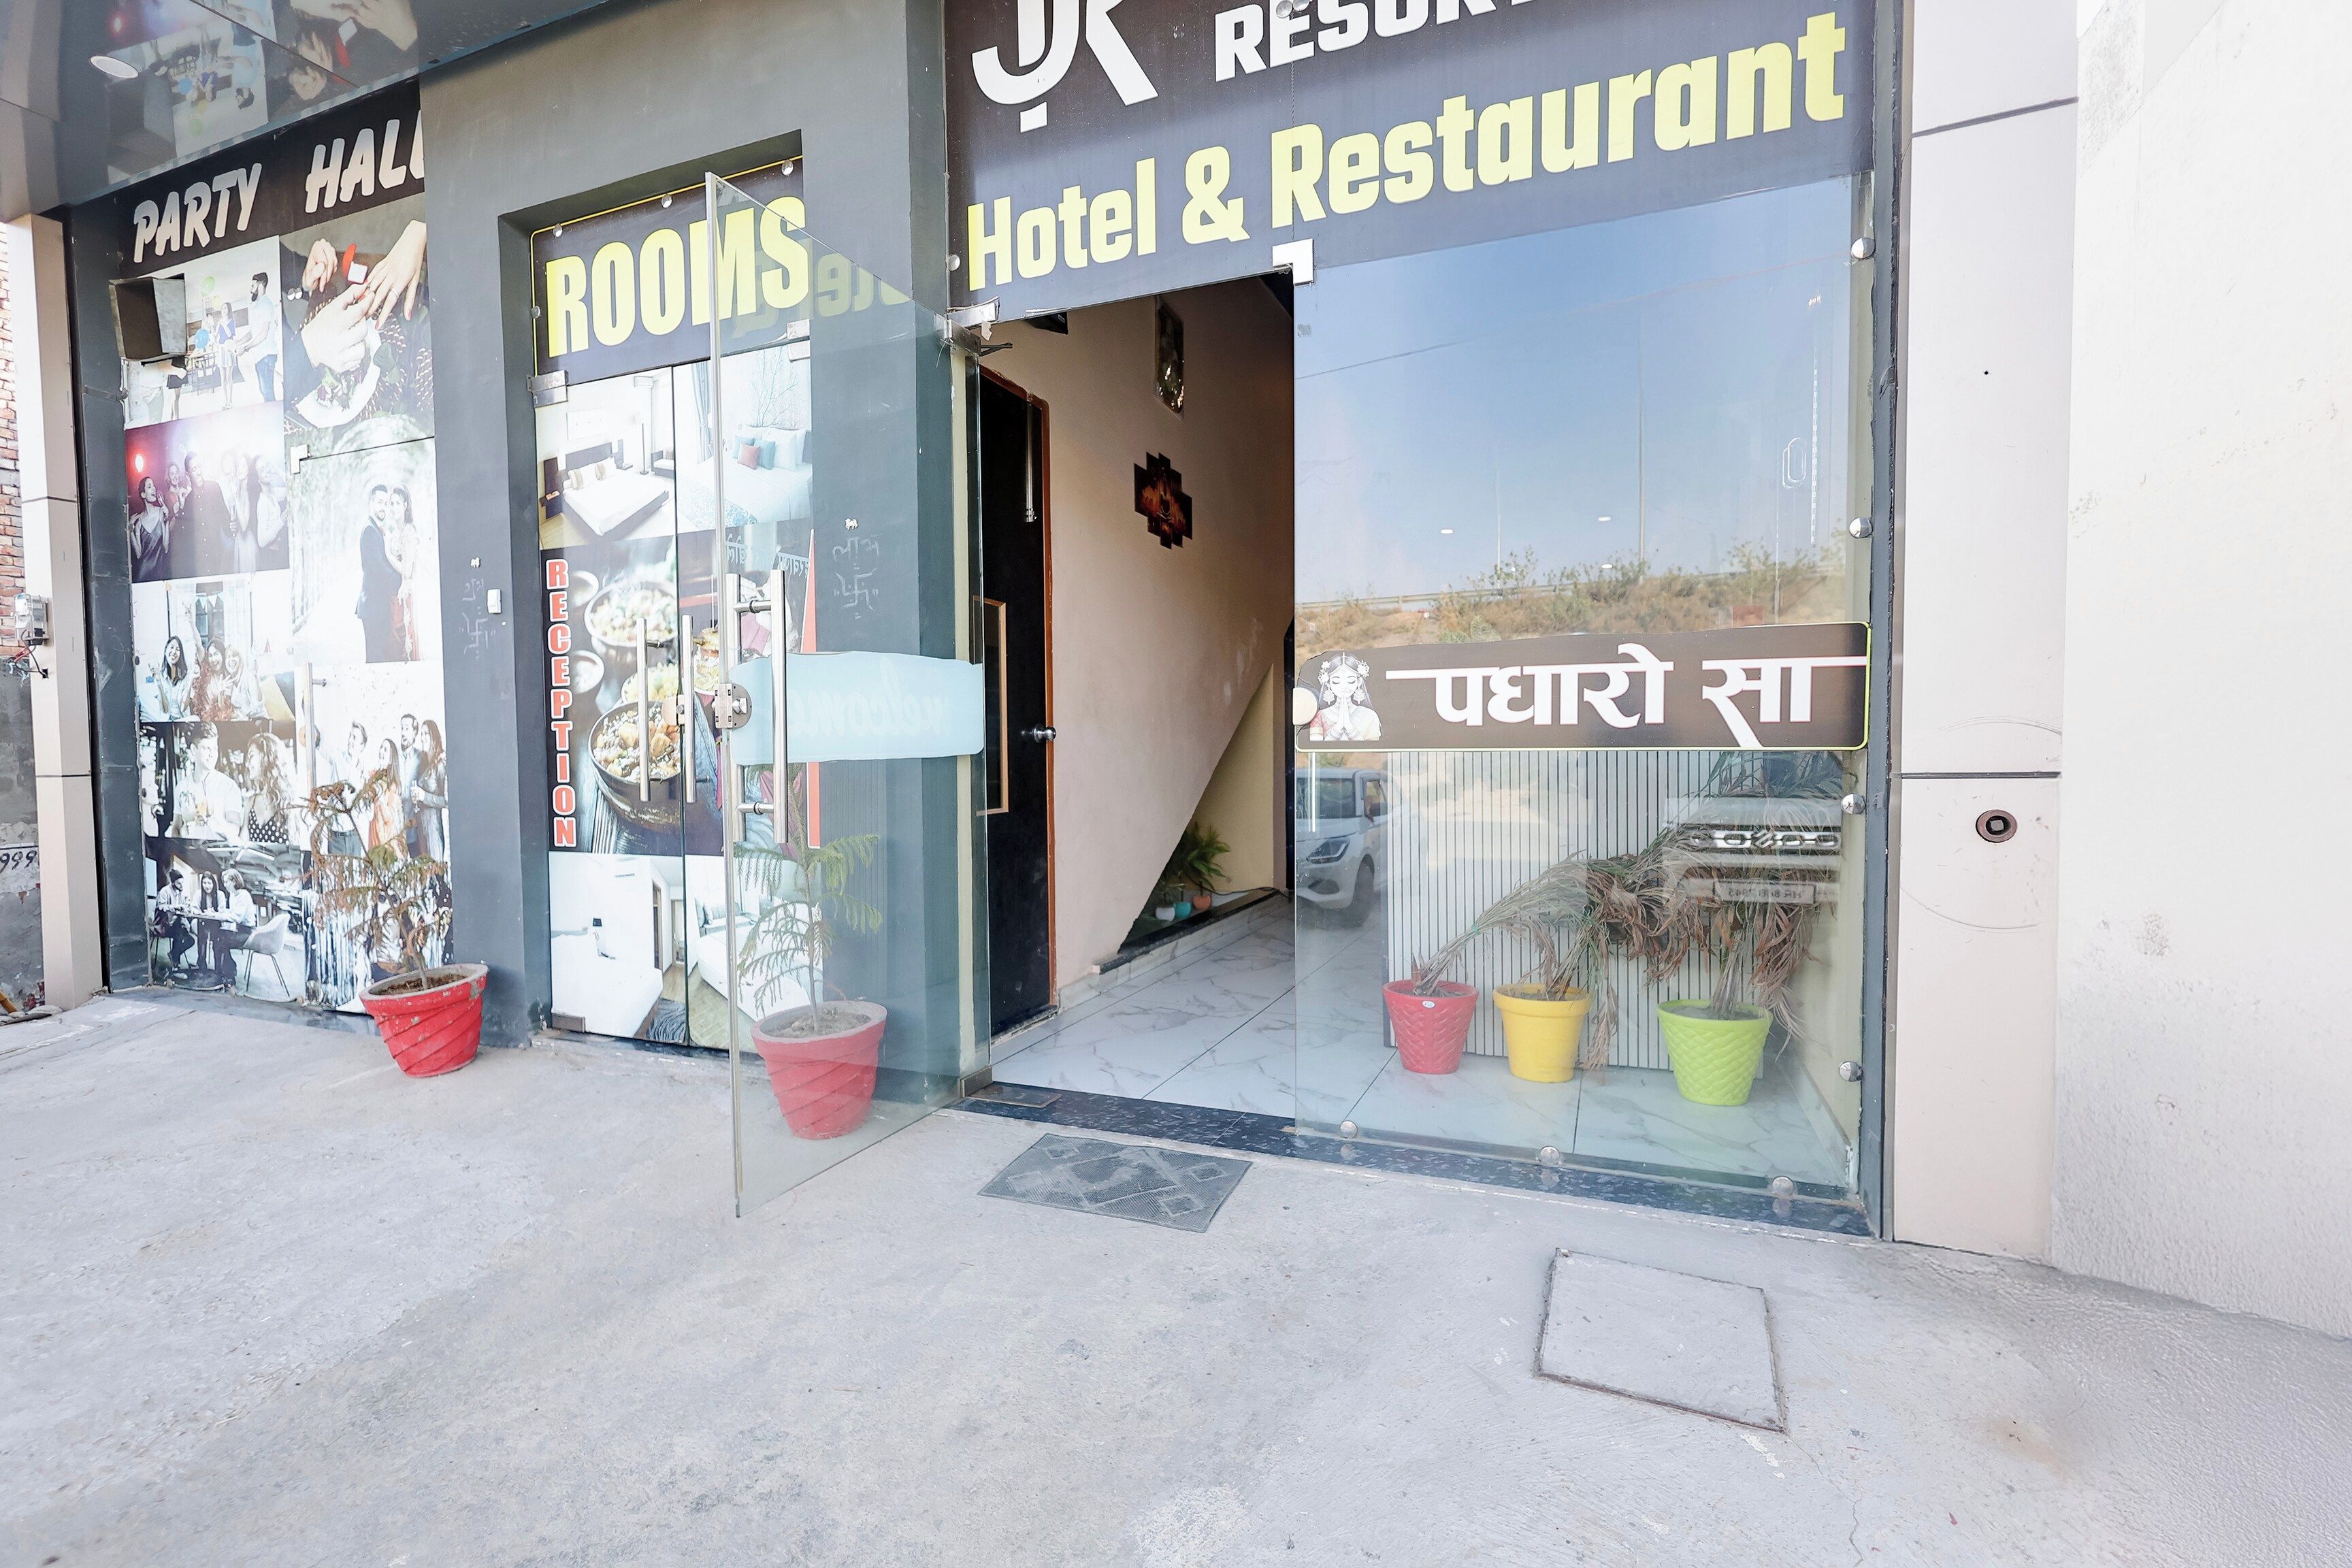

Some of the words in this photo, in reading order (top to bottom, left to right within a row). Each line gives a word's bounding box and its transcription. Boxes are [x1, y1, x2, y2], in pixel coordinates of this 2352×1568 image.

[133, 163, 263, 263] PARTY
[967, 157, 1157, 291] Hotel
[1181, 145, 1251, 245] &
[1271, 12, 1846, 229] Restaurant
[546, 195, 809, 359] ROOMS
[545, 558, 577, 848] RECEPTION
[1385, 642, 1675, 730] पधारो
[1701, 655, 1869, 748] सा
